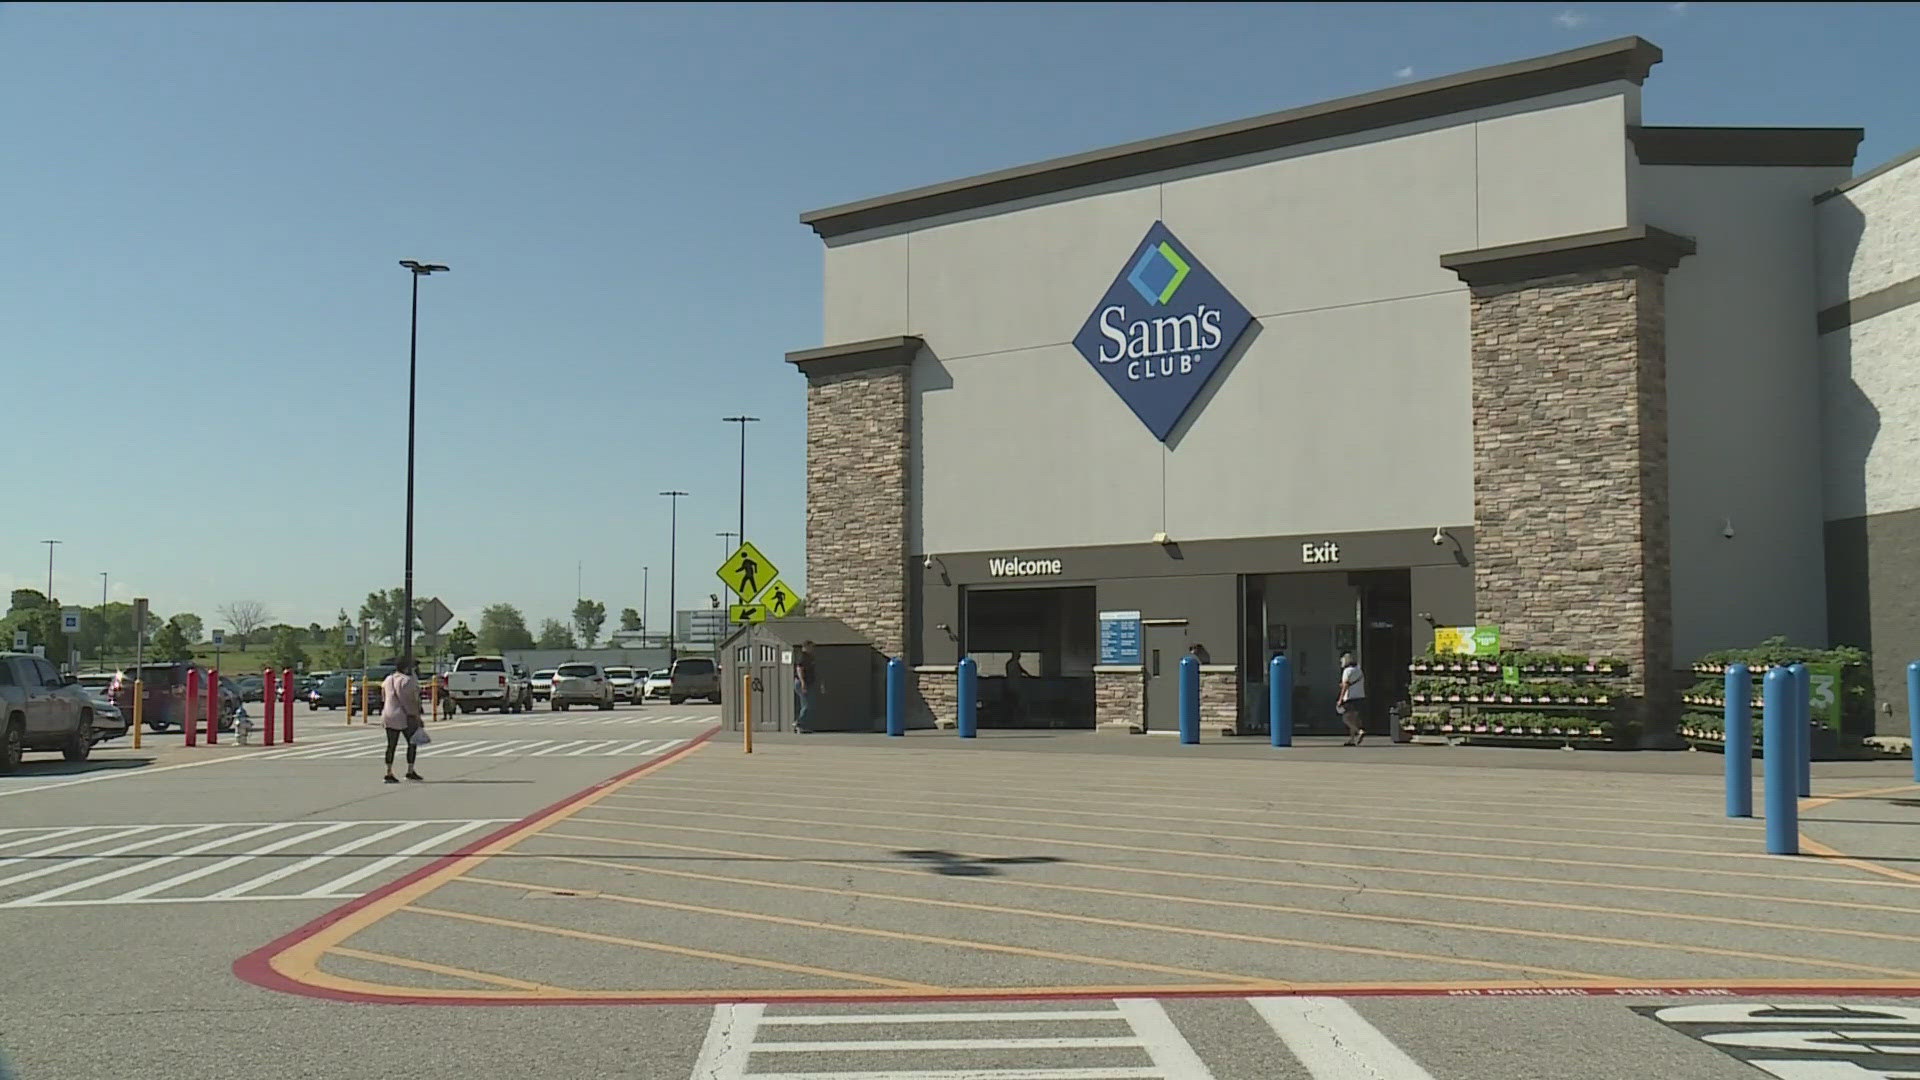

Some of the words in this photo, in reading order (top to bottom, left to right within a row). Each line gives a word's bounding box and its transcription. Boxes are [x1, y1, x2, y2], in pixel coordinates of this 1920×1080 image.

[1099, 304, 1222, 364] Sam's
[988, 556, 1063, 577] Welcome
[1302, 541, 1340, 564] Exit
[1808, 674, 1835, 709] 3
